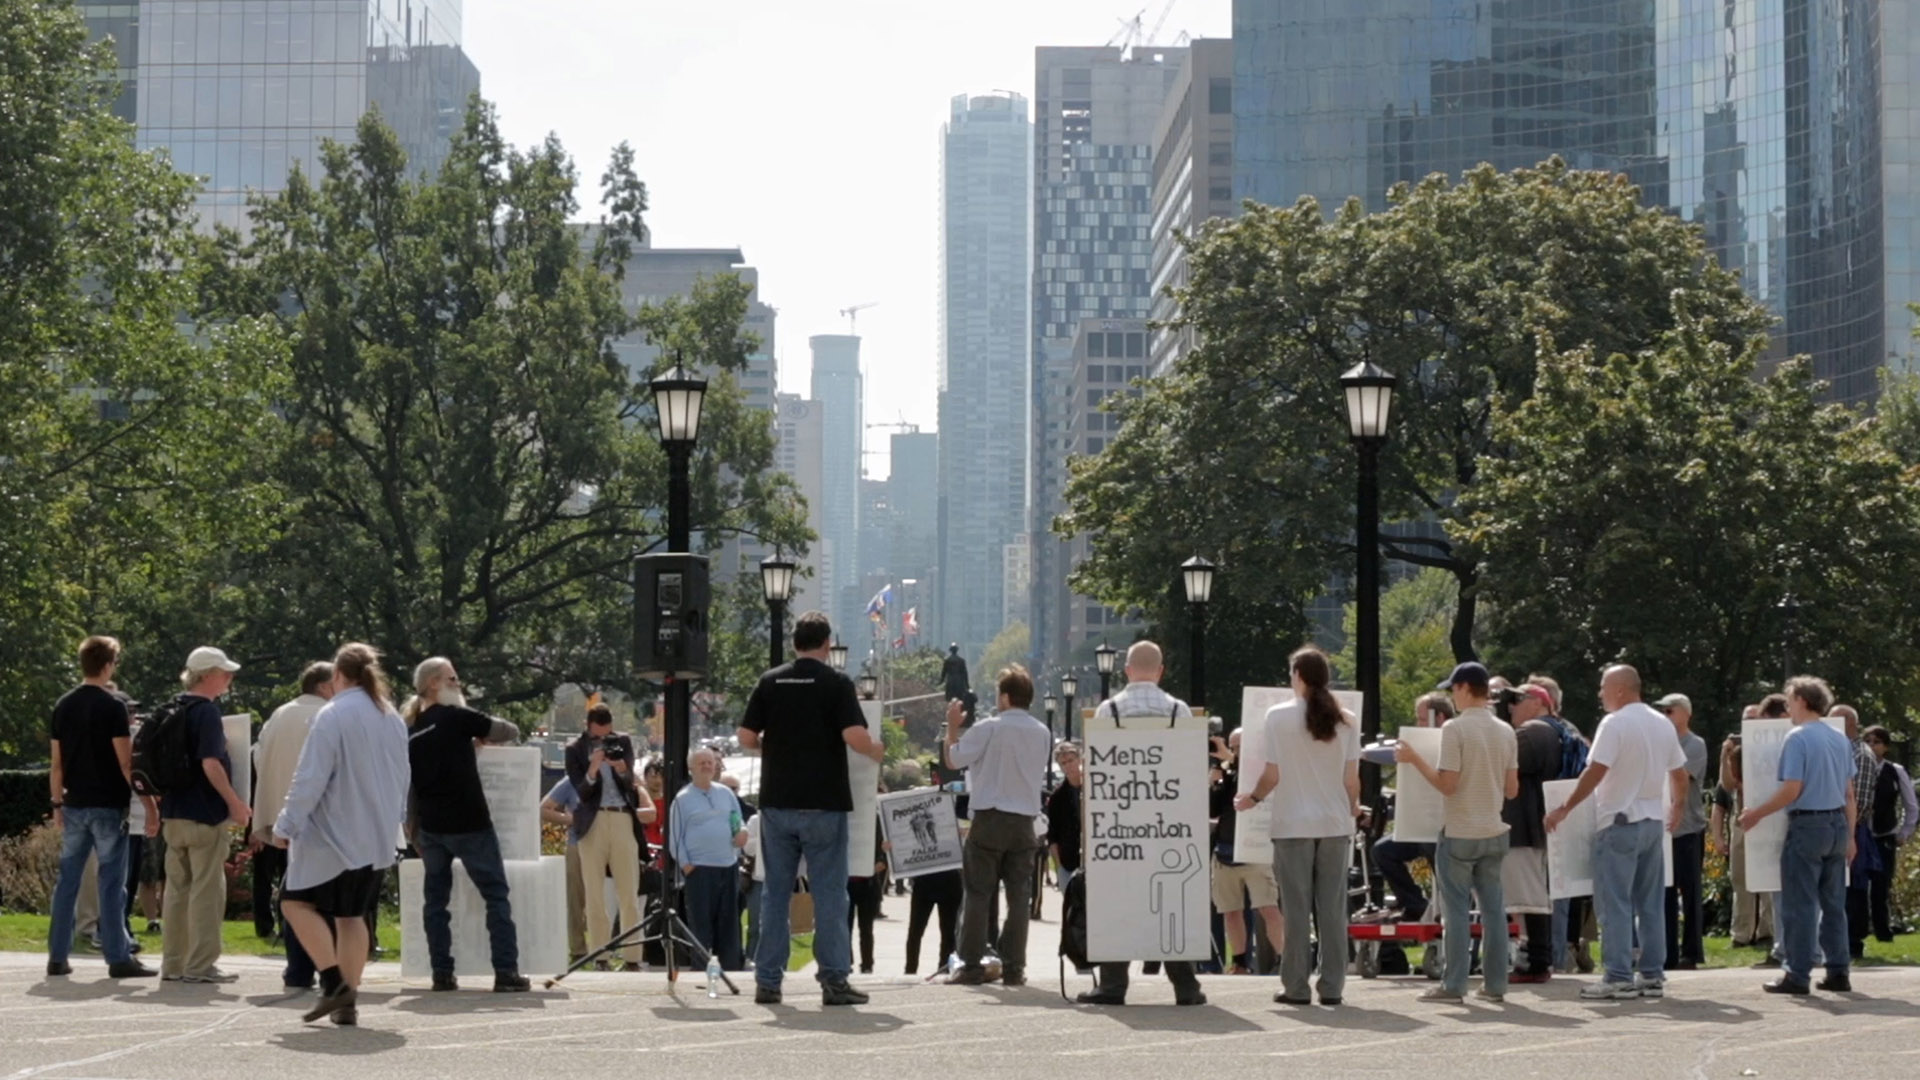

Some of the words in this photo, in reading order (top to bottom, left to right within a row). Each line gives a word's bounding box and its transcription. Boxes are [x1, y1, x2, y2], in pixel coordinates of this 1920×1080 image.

[1089, 745, 1163, 766] Mens
[1089, 770, 1180, 810] Rights
[1091, 812, 1192, 839] Edmonton
[1092, 843, 1144, 862] .com
